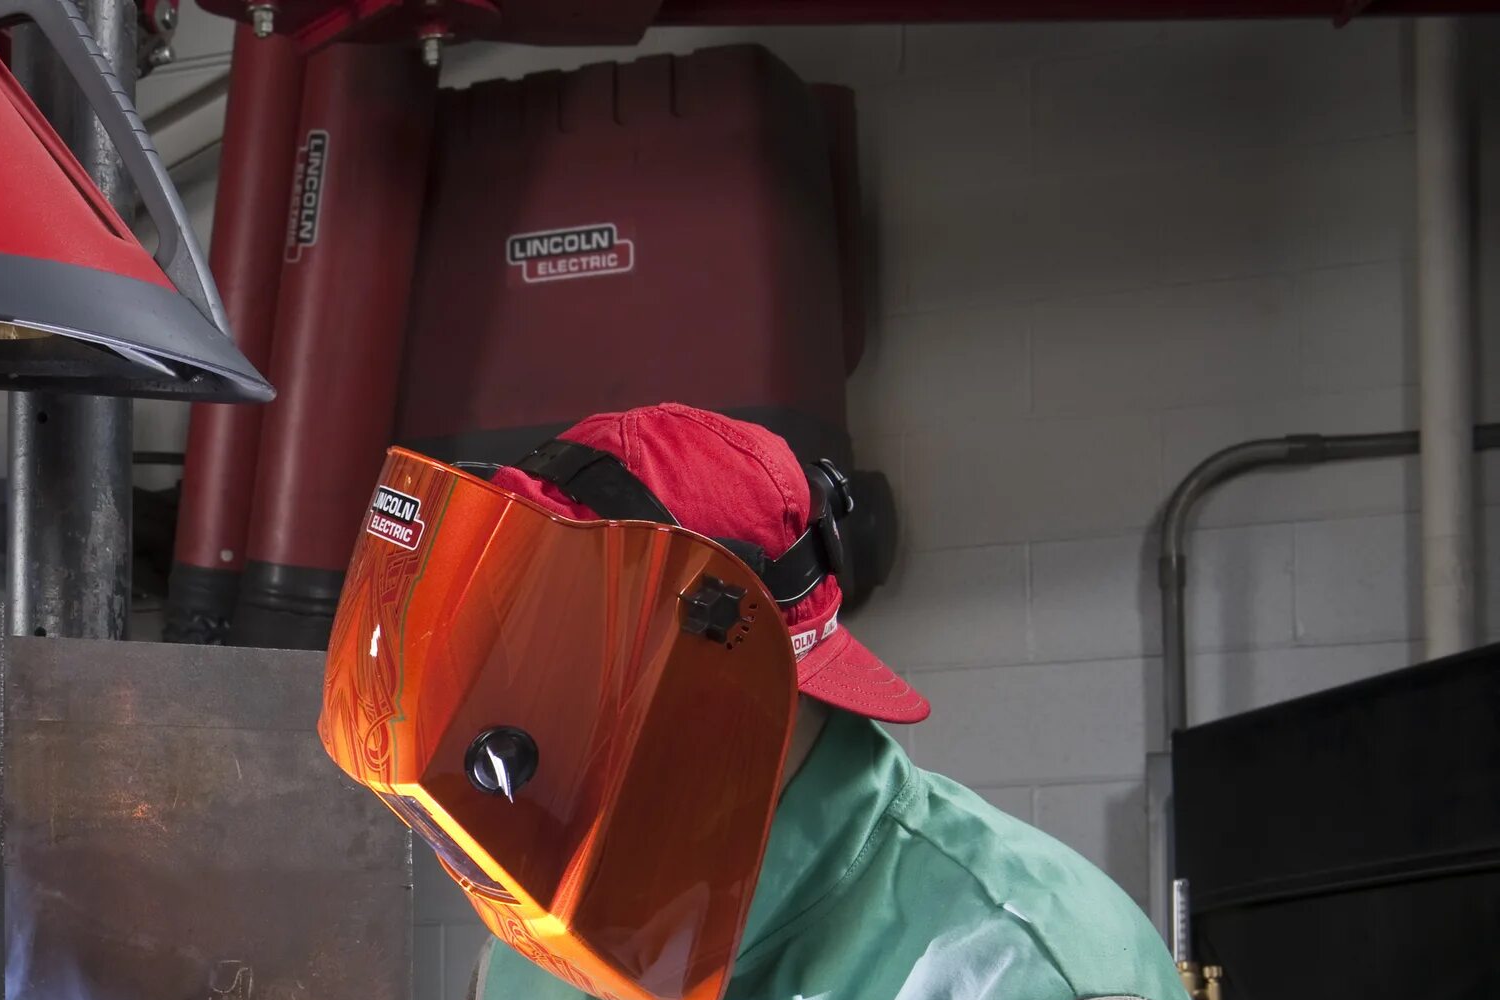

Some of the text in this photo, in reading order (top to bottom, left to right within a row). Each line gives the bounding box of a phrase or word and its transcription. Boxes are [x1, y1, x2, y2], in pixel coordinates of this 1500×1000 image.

[299, 138, 323, 239] LINCOLN
[514, 230, 609, 259] LINCOLN
[537, 253, 618, 275] ELECTRIC
[373, 491, 415, 521] LINCOLN
[371, 514, 413, 542] ELECTRIC
